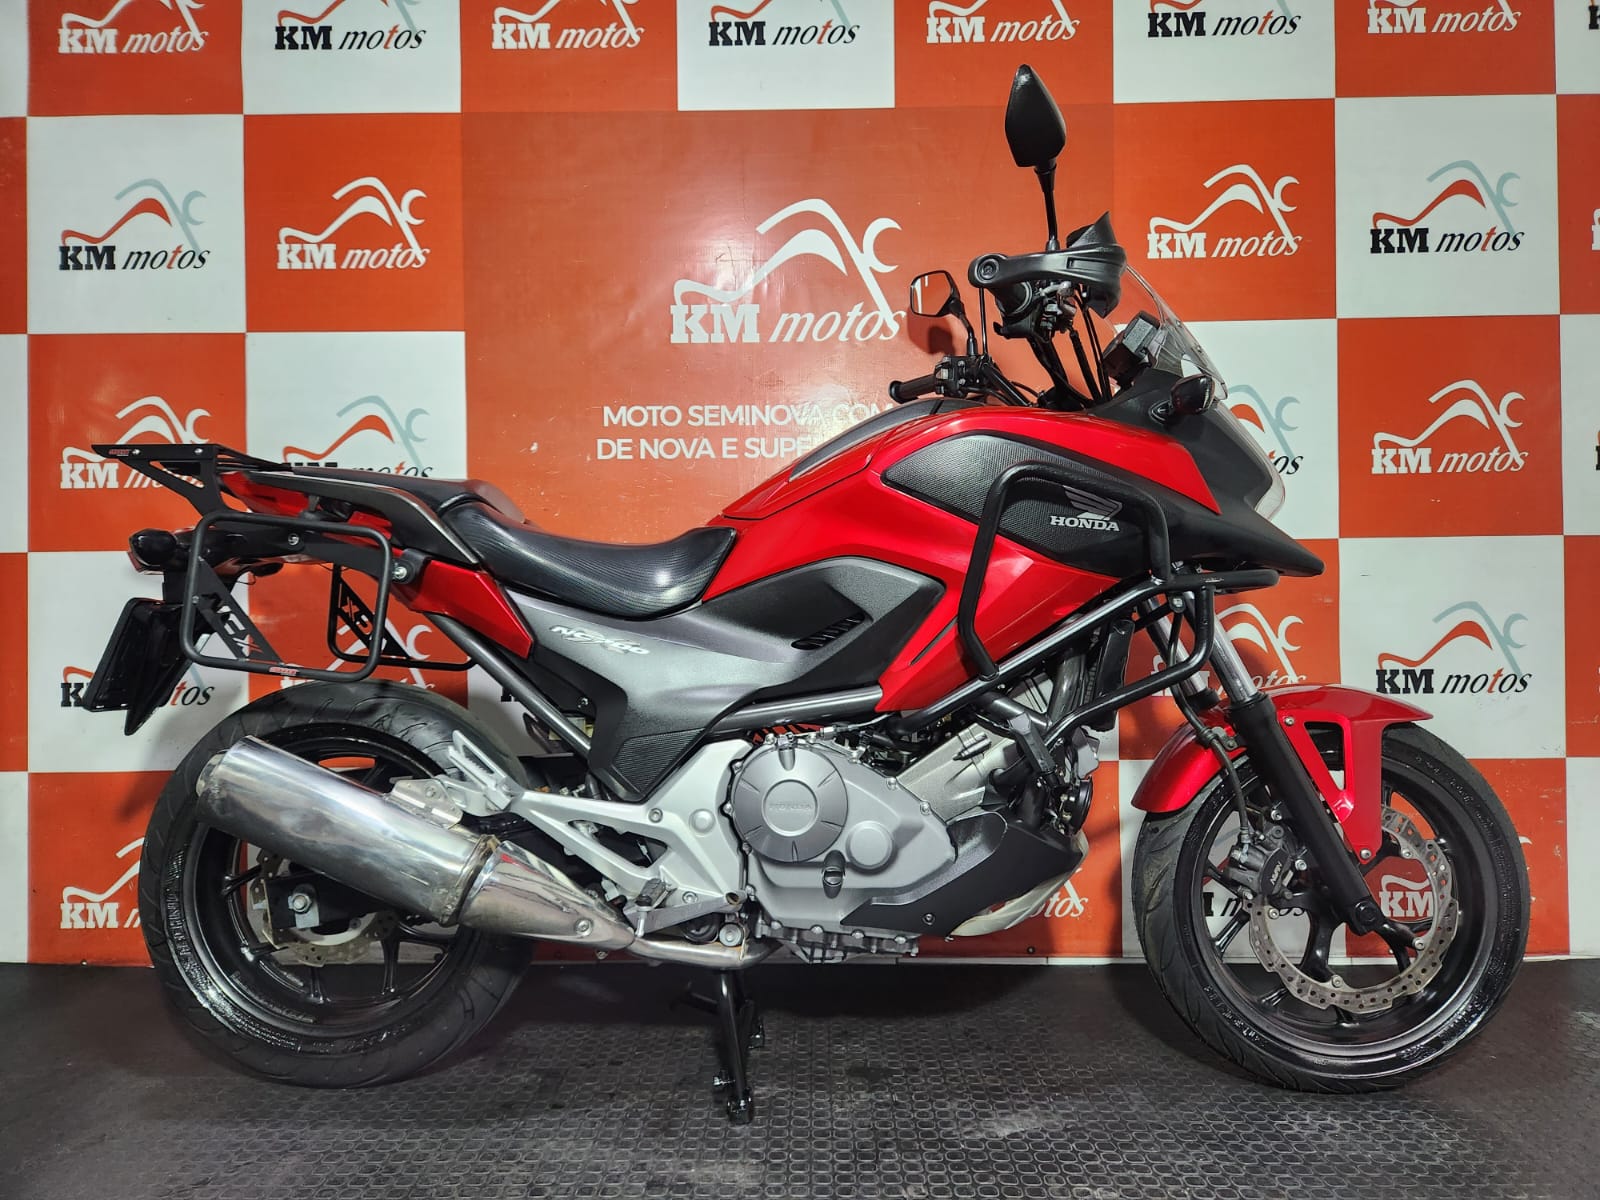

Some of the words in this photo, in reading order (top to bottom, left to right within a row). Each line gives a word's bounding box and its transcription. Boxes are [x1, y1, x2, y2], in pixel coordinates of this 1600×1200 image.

[709, 21, 766, 46] KM
[771, 18, 860, 46] motos
[926, 16, 985, 43] KM
[990, 14, 1080, 42] motos
[1147, 11, 1206, 38] KM
[1212, 9, 1301, 36] motos
[1367, 7, 1427, 34] KM
[1431, 5, 1522, 33] motos
[58, 28, 118, 54] KM
[121, 25, 209, 54] motos
[275, 25, 332, 50] KM
[338, 23, 427, 50] motos
[491, 23, 550, 49] KM
[554, 20, 645, 49] motos
[1147, 232, 1207, 260] KM
[1211, 230, 1302, 258] motos
[1370, 228, 1429, 254] KM
[1435, 225, 1525, 253] motos
[59, 245, 116, 270] KM
[122, 242, 210, 270] motos
[277, 243, 337, 270] KM
[341, 241, 430, 270] motos
[670, 304, 760, 343] KM
[768, 300, 906, 343] motos
[603, 405, 682, 427] MOTO
[688, 404, 826, 427] SEMINOVA
[597, 438, 633, 460] DE
[640, 438, 716, 459] NOVA
[722, 438, 738, 459] E
[1371, 447, 1432, 474] KM
[1436, 445, 1529, 473] motos
[60, 463, 119, 488] KM
[1050, 515, 1120, 532] HONDA
[1376, 668, 1434, 694] KM
[1439, 667, 1532, 694] motos
[60, 902, 119, 929] KM
[1379, 891, 1434, 918] KM
